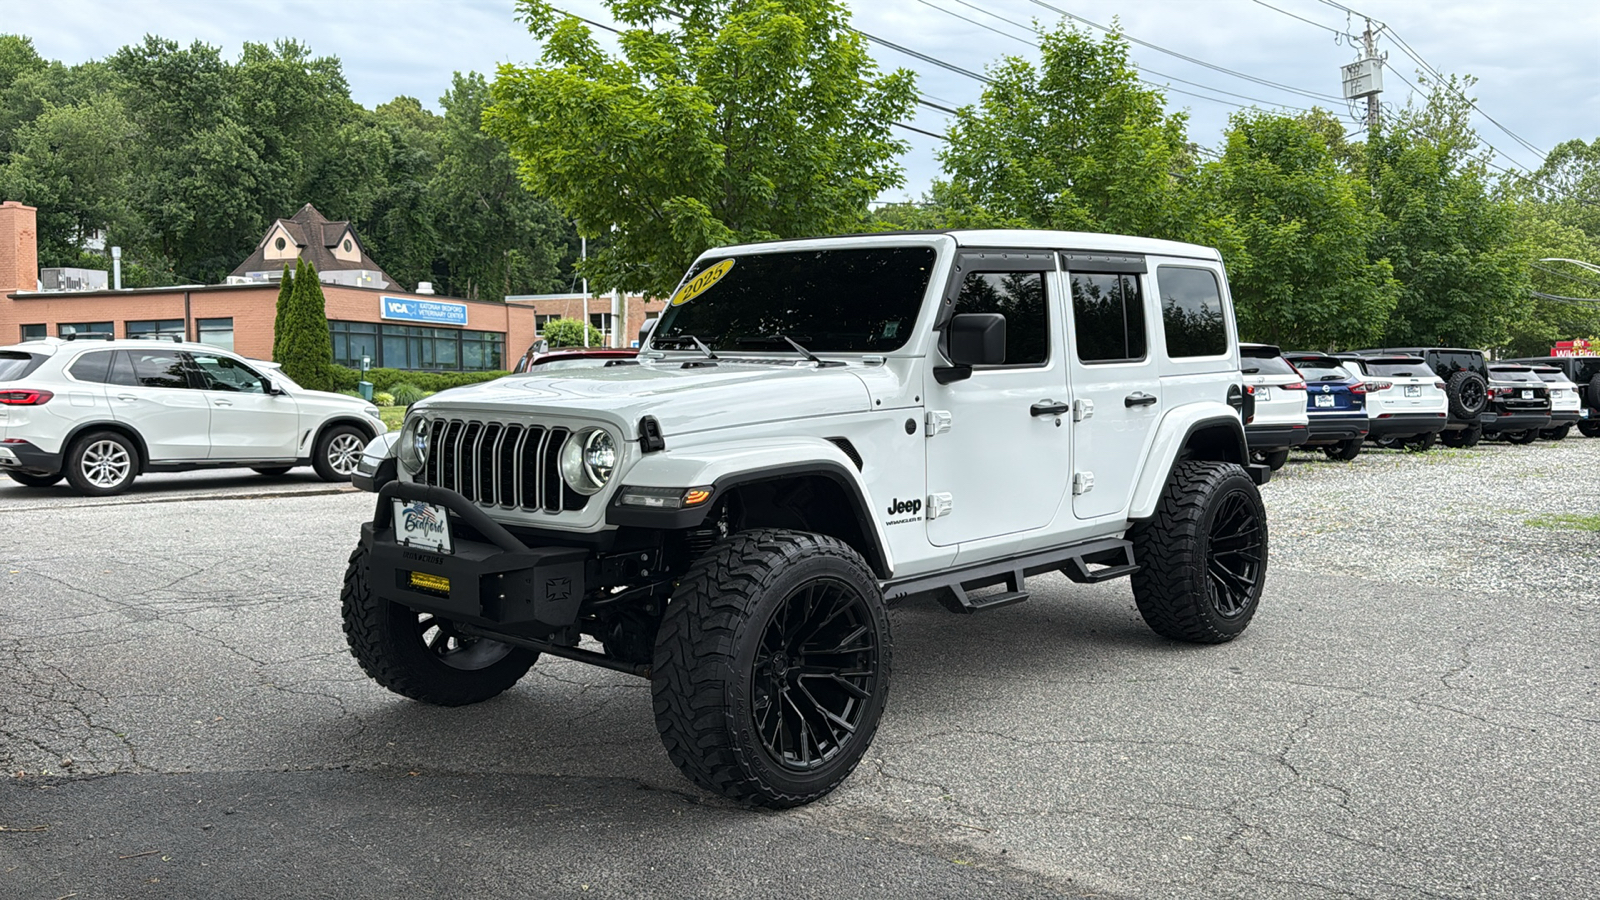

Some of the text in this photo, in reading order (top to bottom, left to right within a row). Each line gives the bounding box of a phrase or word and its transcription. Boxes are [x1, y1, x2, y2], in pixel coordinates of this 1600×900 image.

[683, 264, 723, 300] 2025
[388, 303, 408, 313] VCA
[441, 305, 463, 313] BEDFORD
[887, 498, 922, 515] Jeep
[402, 508, 445, 538] Bedford
[885, 517, 916, 525] WRANGLER
[741, 728, 771, 778] TOYO
